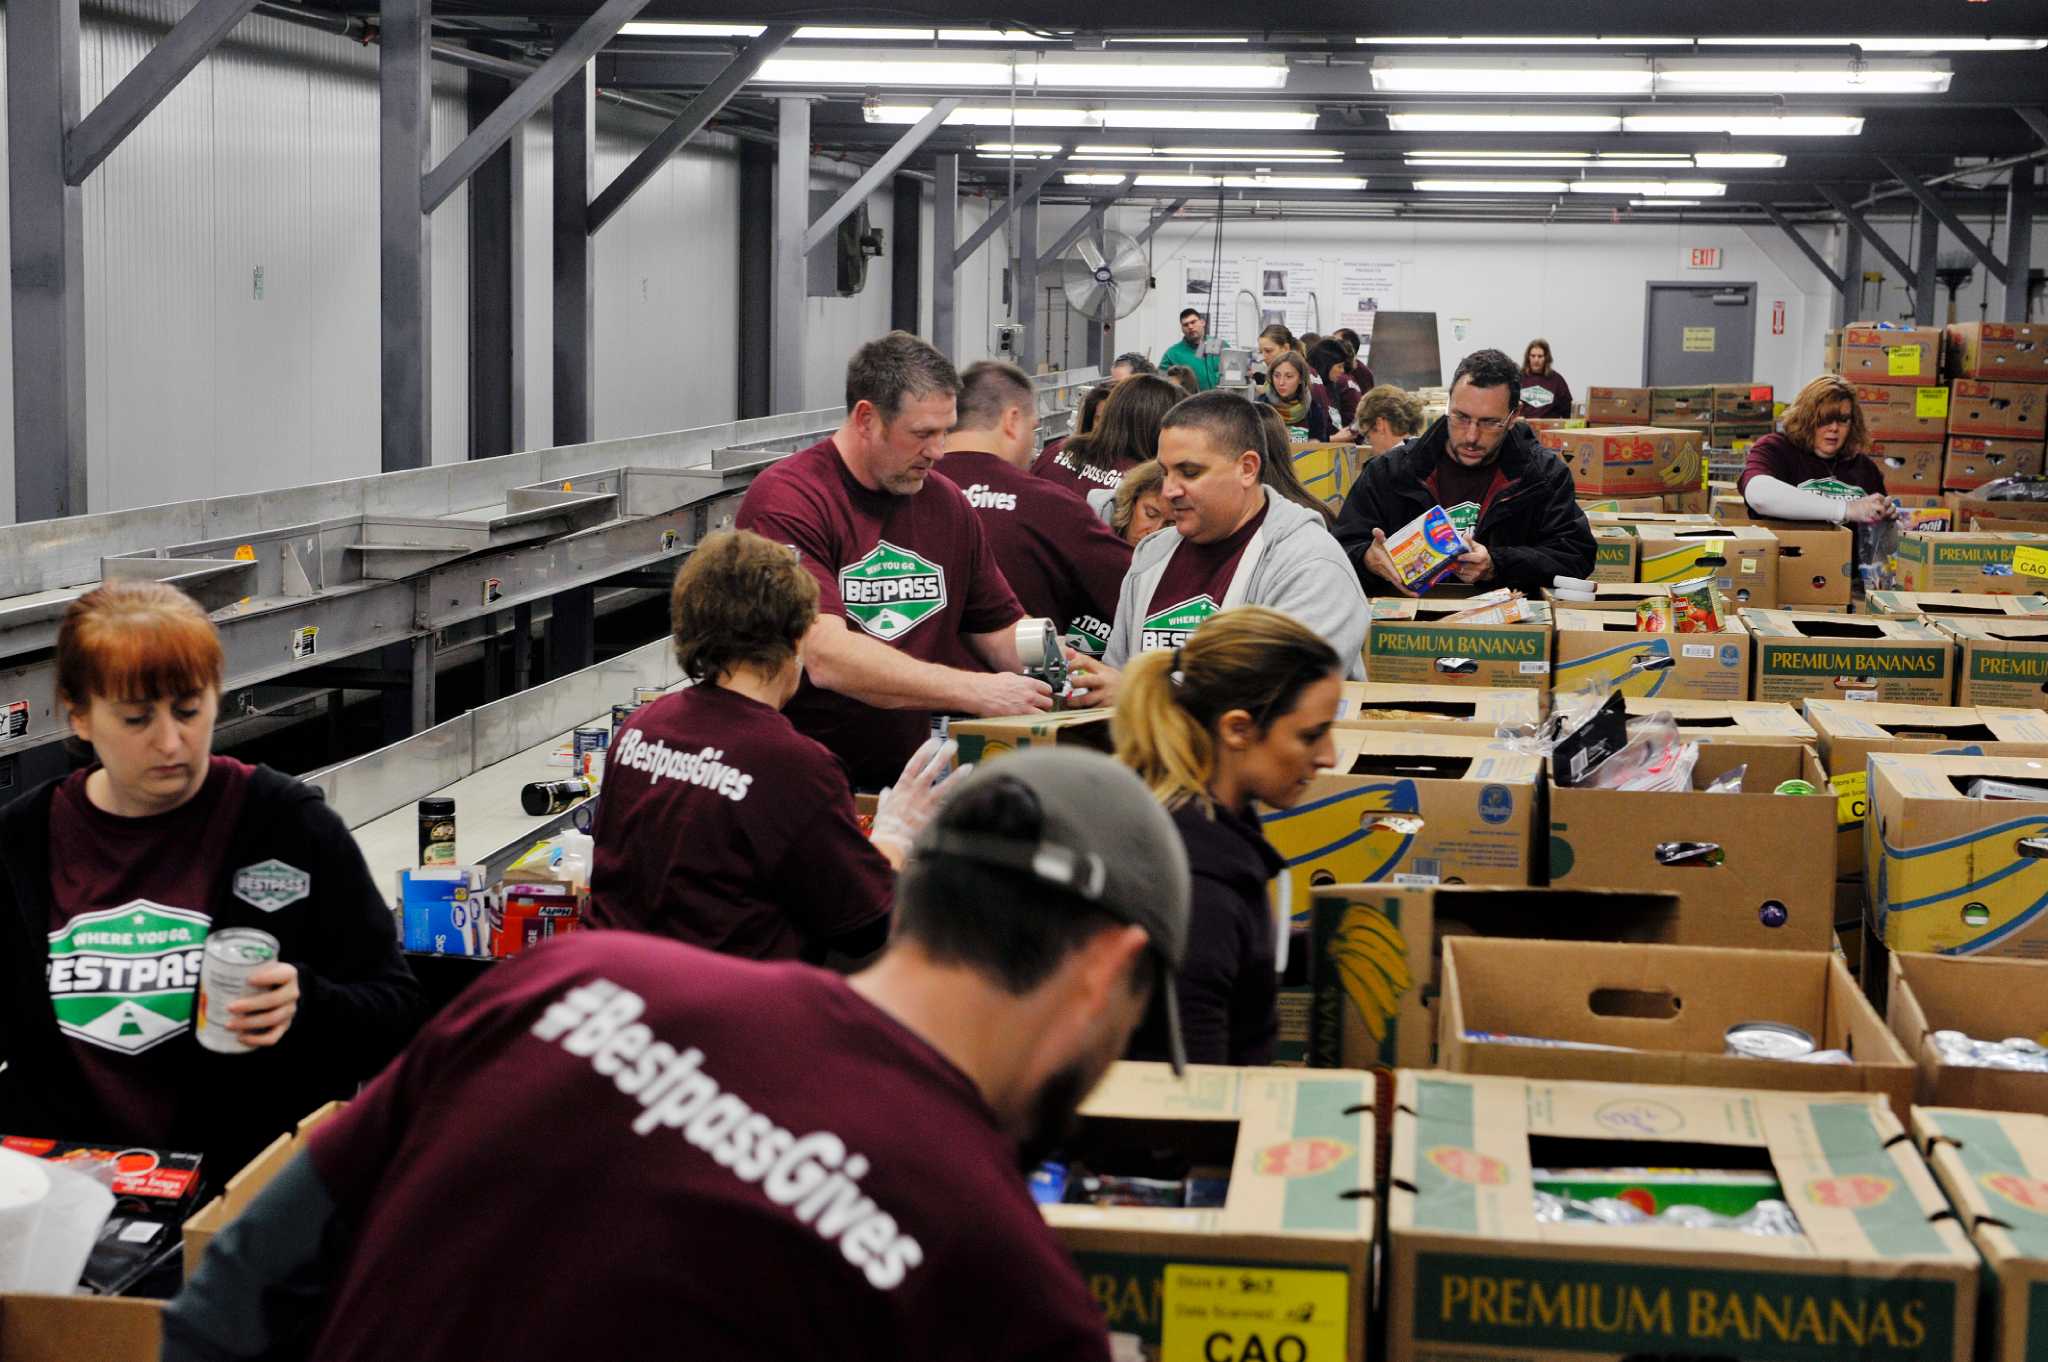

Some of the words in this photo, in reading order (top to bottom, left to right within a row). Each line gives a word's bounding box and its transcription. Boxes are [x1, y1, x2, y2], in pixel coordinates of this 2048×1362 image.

[1692, 248, 1716, 266] EXIT
[1603, 435, 1654, 462] Dole
[1940, 547, 1997, 561] PREMIUM
[882, 561, 900, 571] YOU
[2020, 561, 2047, 575] CAO
[845, 577, 939, 603] BESTPASS
[1168, 615, 1201, 626] WHERE
[1378, 633, 1453, 651] PREMIUM
[1458, 636, 1536, 655] BANANAS
[1771, 652, 1851, 670] PREMIUM
[1855, 654, 1936, 672] BANANAS
[614, 728, 754, 801] #BestpassGives
[72, 930, 133, 947] WHERE
[136, 929, 169, 945] YOU
[531, 978, 924, 1290] #BestpassGives
[1439, 1273, 1673, 1337] PREMIUM
[1687, 1289, 1927, 1349] BANANAS
